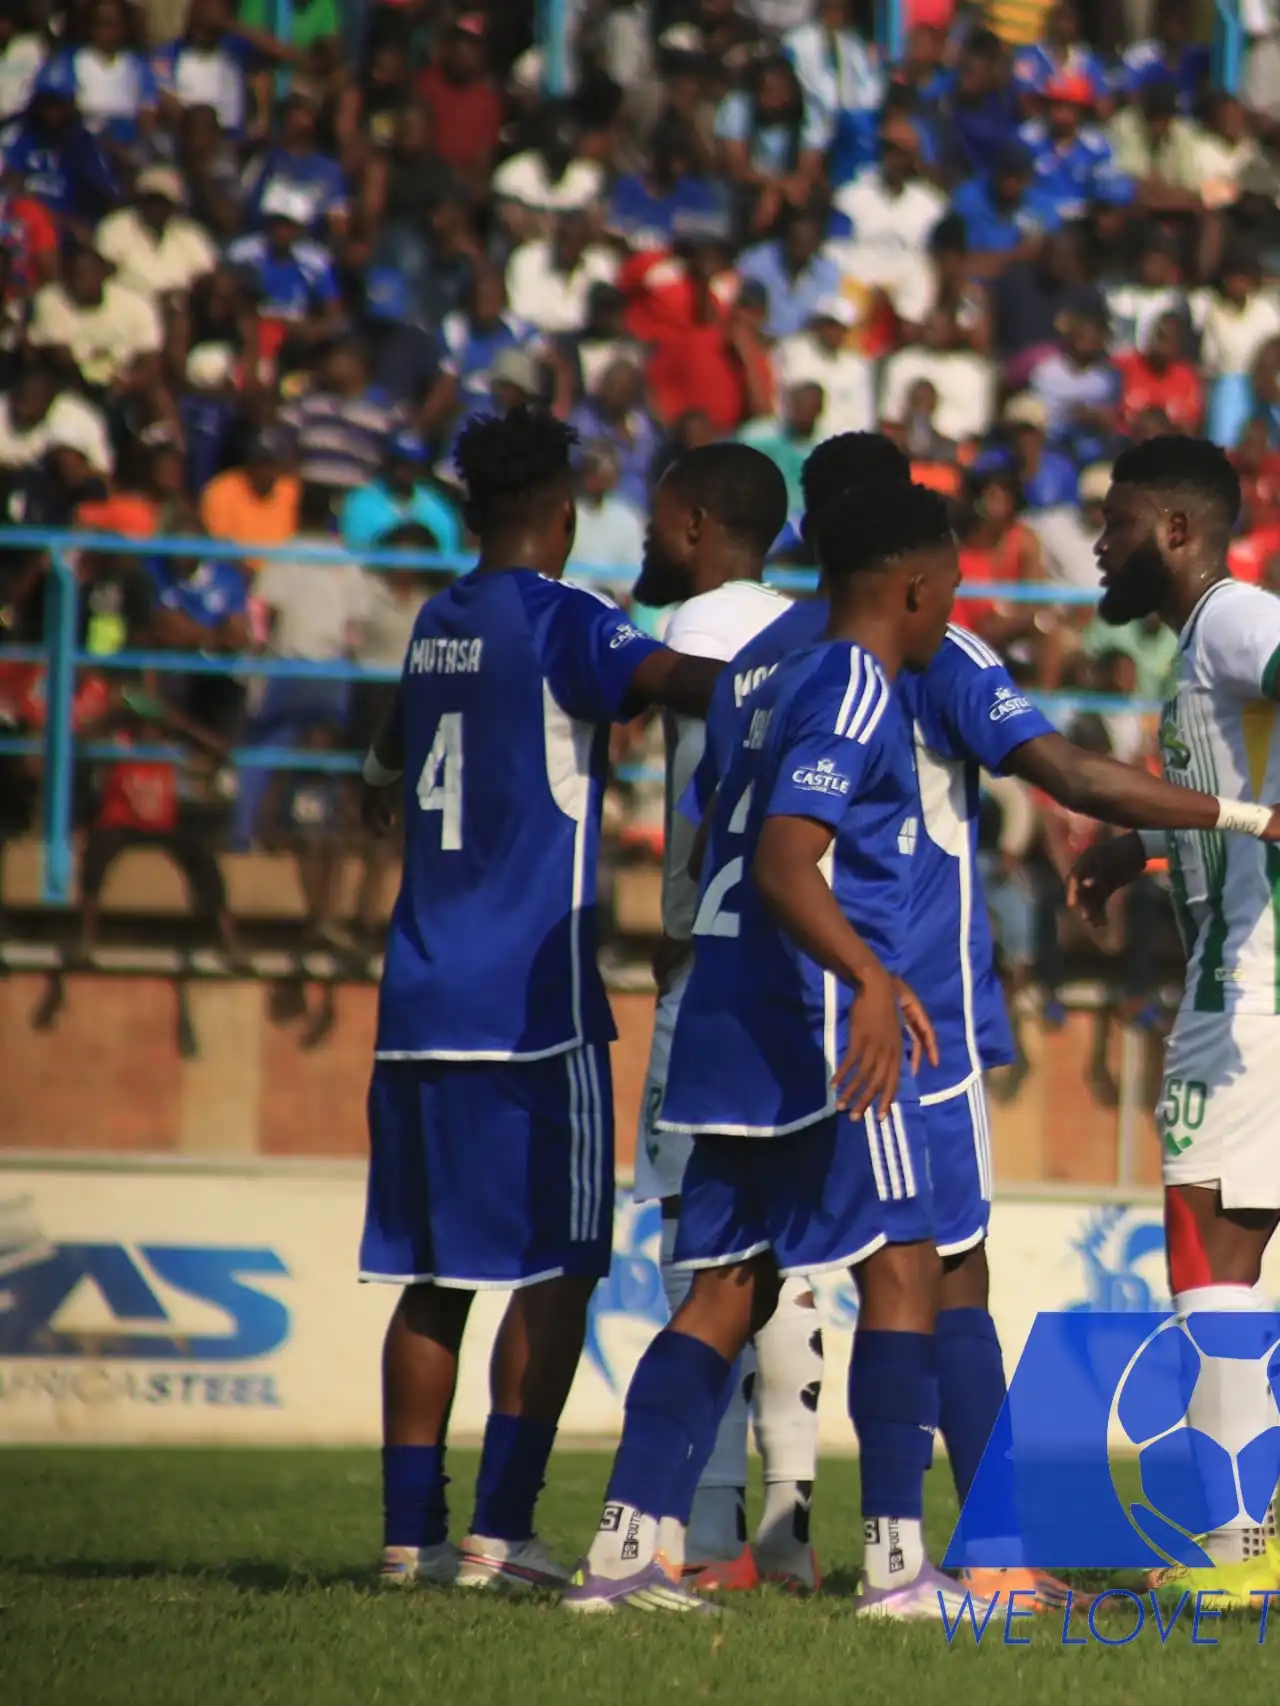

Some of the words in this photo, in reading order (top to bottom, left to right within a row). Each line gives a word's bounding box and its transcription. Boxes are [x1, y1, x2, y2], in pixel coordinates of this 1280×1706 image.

[409, 637, 483, 674] MUTASA
[416, 711, 463, 850] 4
[792, 769, 850, 795] CASTLE
